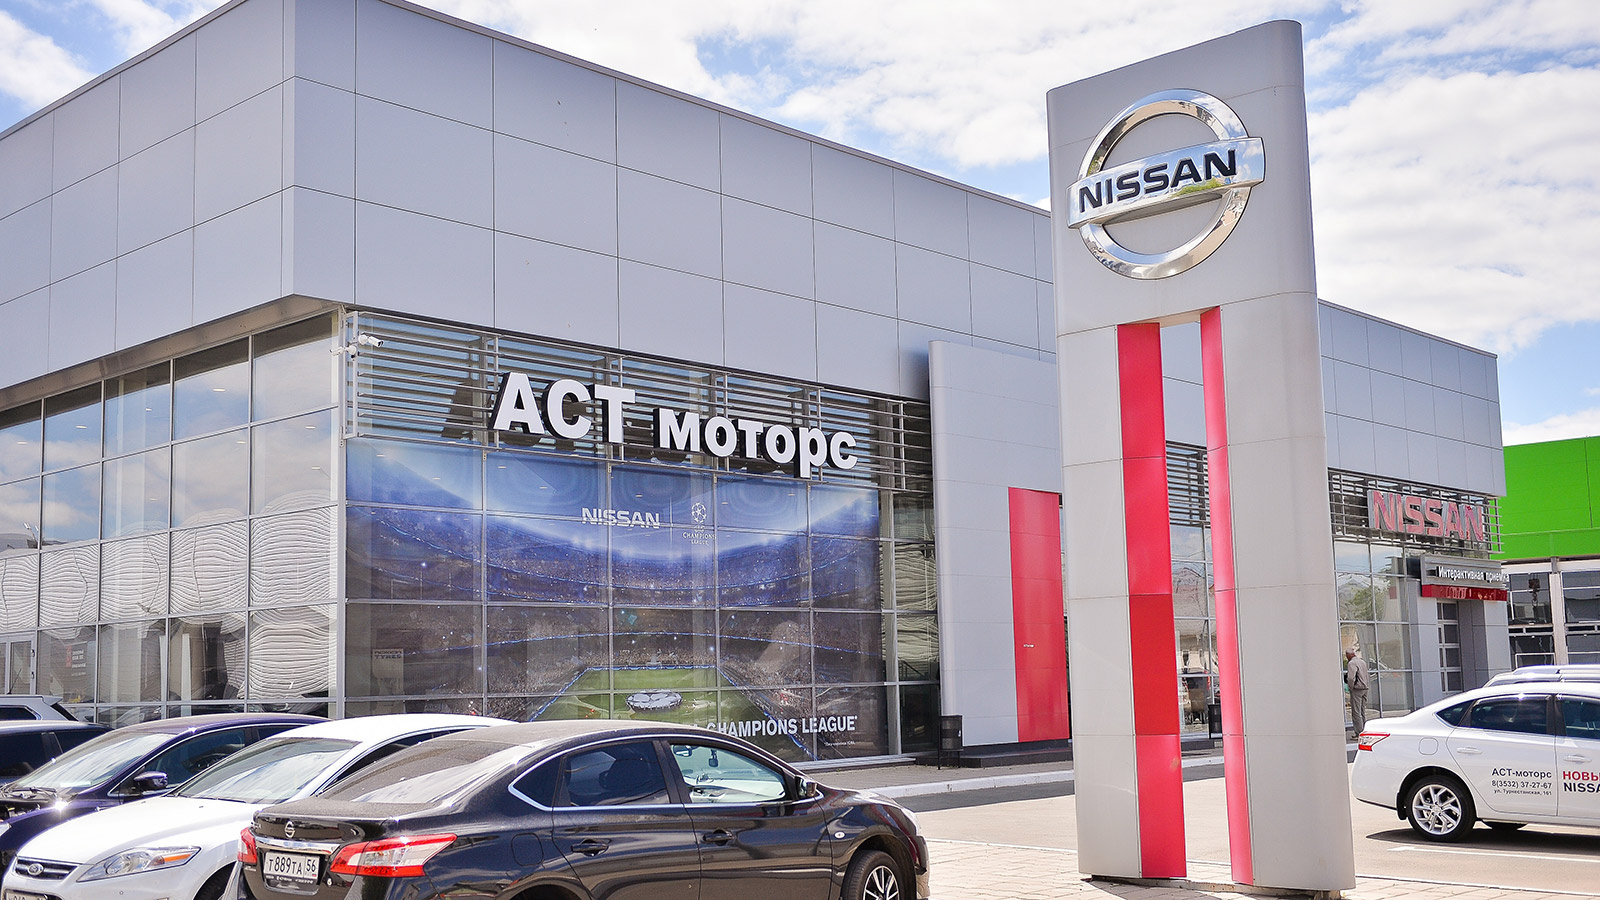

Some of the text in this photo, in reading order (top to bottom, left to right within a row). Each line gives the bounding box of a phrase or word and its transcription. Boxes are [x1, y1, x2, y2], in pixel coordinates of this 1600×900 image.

[1079, 149, 1237, 214] NISSAN
[492, 372, 858, 478] АСТ моторс
[582, 507, 660, 529] NISSAN
[1368, 490, 1484, 542] NISSAN
[682, 532, 716, 540] CHAMPIONS
[1492, 780, 1552, 789] 8(3532) 37-27-67
[306, 859, 316, 872] 56
